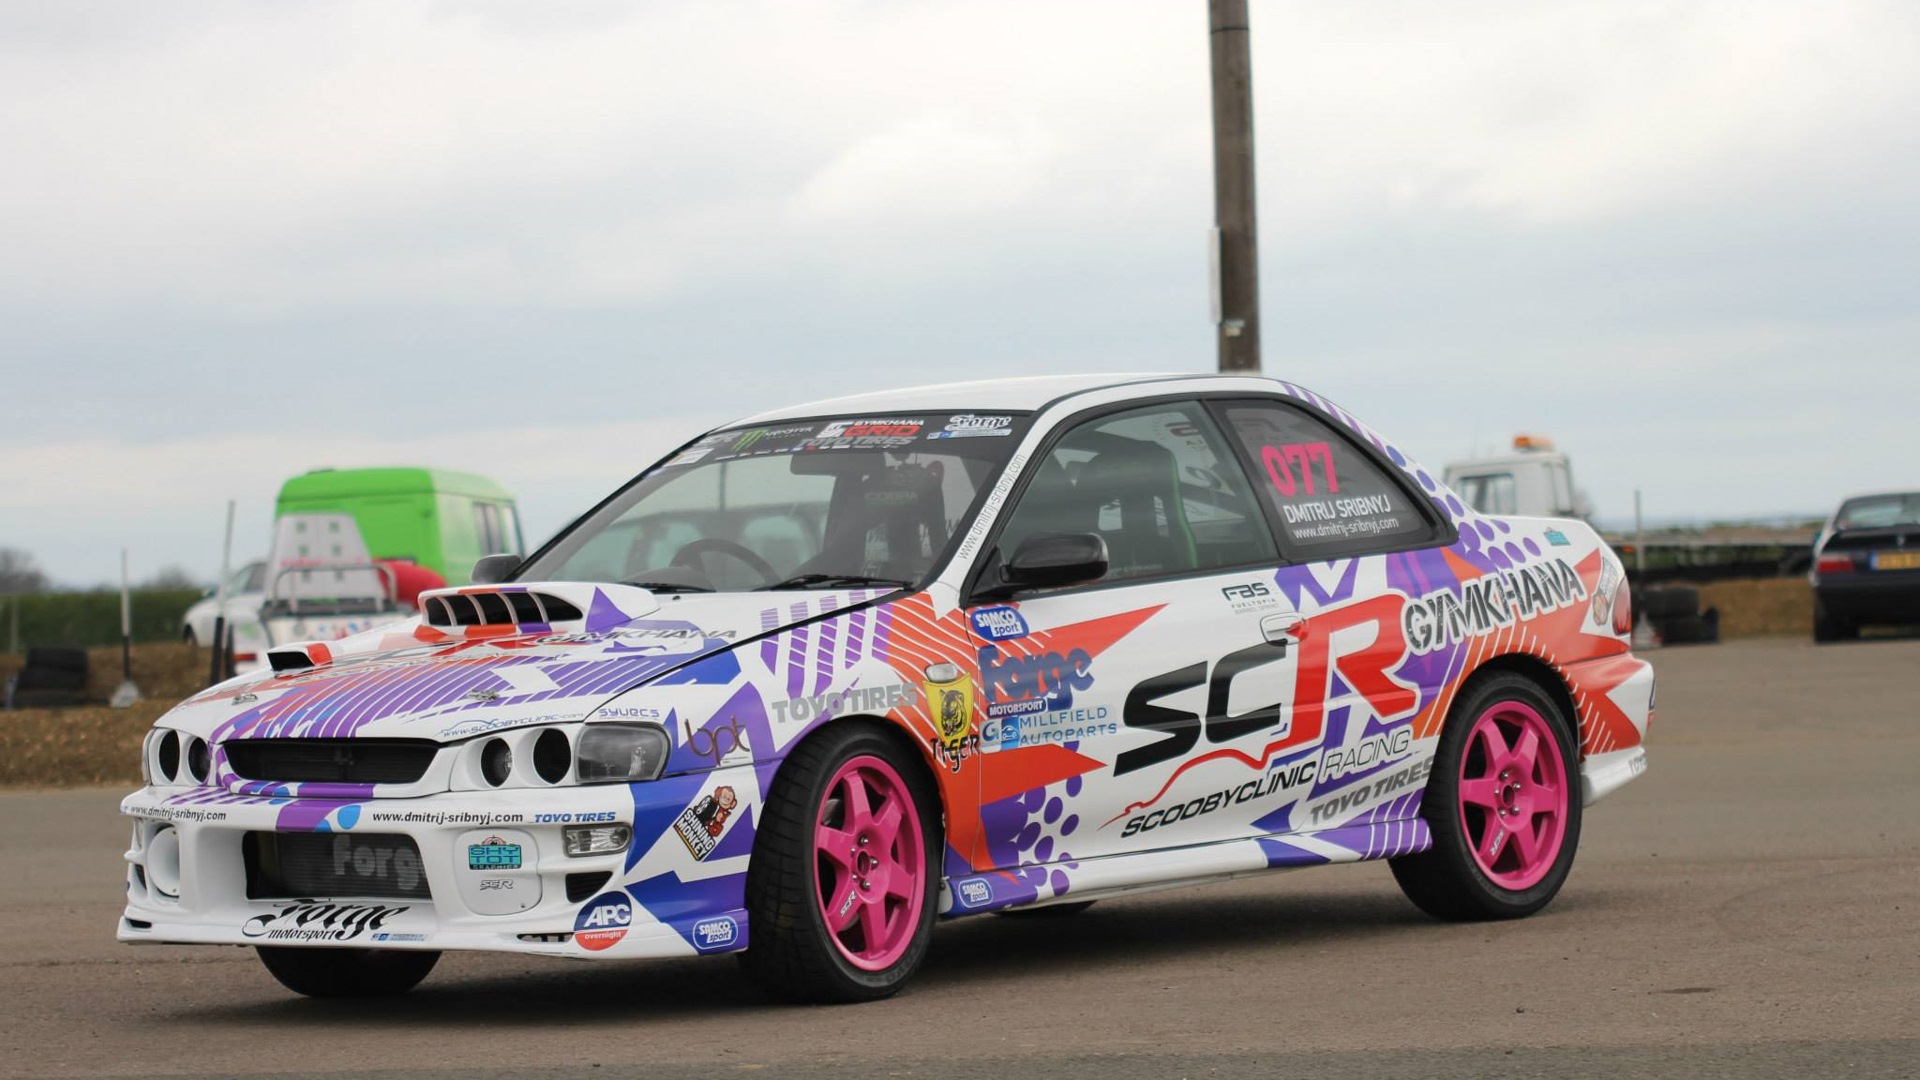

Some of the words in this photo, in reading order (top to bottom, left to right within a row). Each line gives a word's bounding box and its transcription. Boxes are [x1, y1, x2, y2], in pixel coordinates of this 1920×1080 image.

[1261, 441, 1339, 499] 077
[1282, 503, 1336, 524] DMITRIJ
[1339, 494, 1392, 521] SRIBNYJ
[1292, 517, 1399, 540] www.dmitrij-sribnyj.com
[1403, 557, 1586, 653] GYMKHANA
[976, 611, 1016, 629] SAMCO
[993, 623, 1021, 636] sport
[1113, 595, 1417, 778] SCR
[771, 692, 845, 723] TOYO
[842, 682, 918, 713] TIRES
[988, 700, 1044, 716] MOTORSPORT
[1019, 706, 1108, 729] MILLFIELD
[1019, 722, 1118, 746] AUTOPARTS
[1121, 759, 1317, 839] SCOOBYCLINIC
[1322, 729, 1411, 779] RACING
[1310, 784, 1372, 826] TOYO
[1373, 754, 1436, 799] TIRES
[372, 811, 524, 826] www.dmitrij-sribnyj.com
[534, 813, 572, 824] TOYO
[574, 811, 616, 822] TIRES
[676, 815, 708, 859] MONKEY
[683, 808, 717, 853] SHINING
[583, 903, 632, 928] APC
[266, 928, 337, 943] motorsport
[584, 931, 621, 941] overnight
[699, 920, 732, 936] SAMCO
[709, 930, 732, 943] sport
